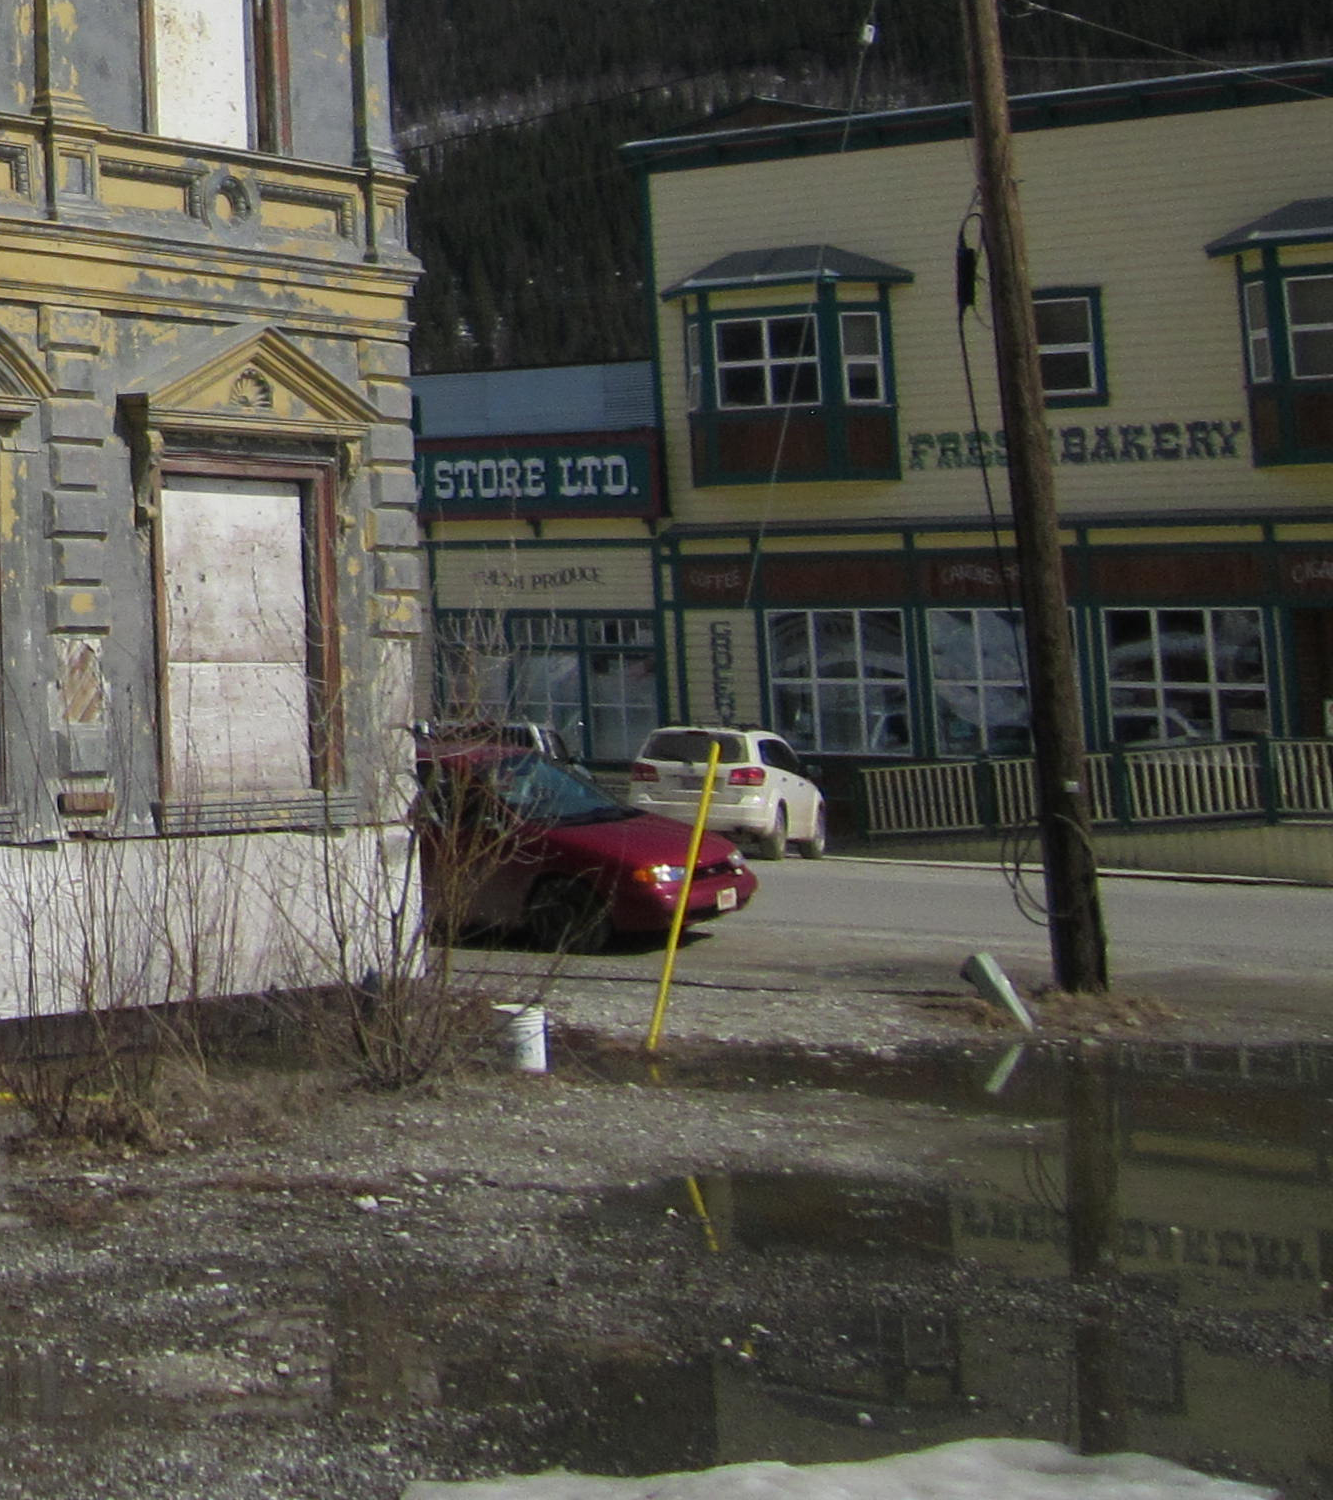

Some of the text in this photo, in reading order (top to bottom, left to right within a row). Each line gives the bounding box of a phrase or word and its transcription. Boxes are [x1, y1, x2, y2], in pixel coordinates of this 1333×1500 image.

[908, 420, 1242, 470] FRES BAKERY
[433, 457, 546, 500] STORE
[557, 454, 640, 498] LTD.
[531, 566, 606, 591] PRODUCE
